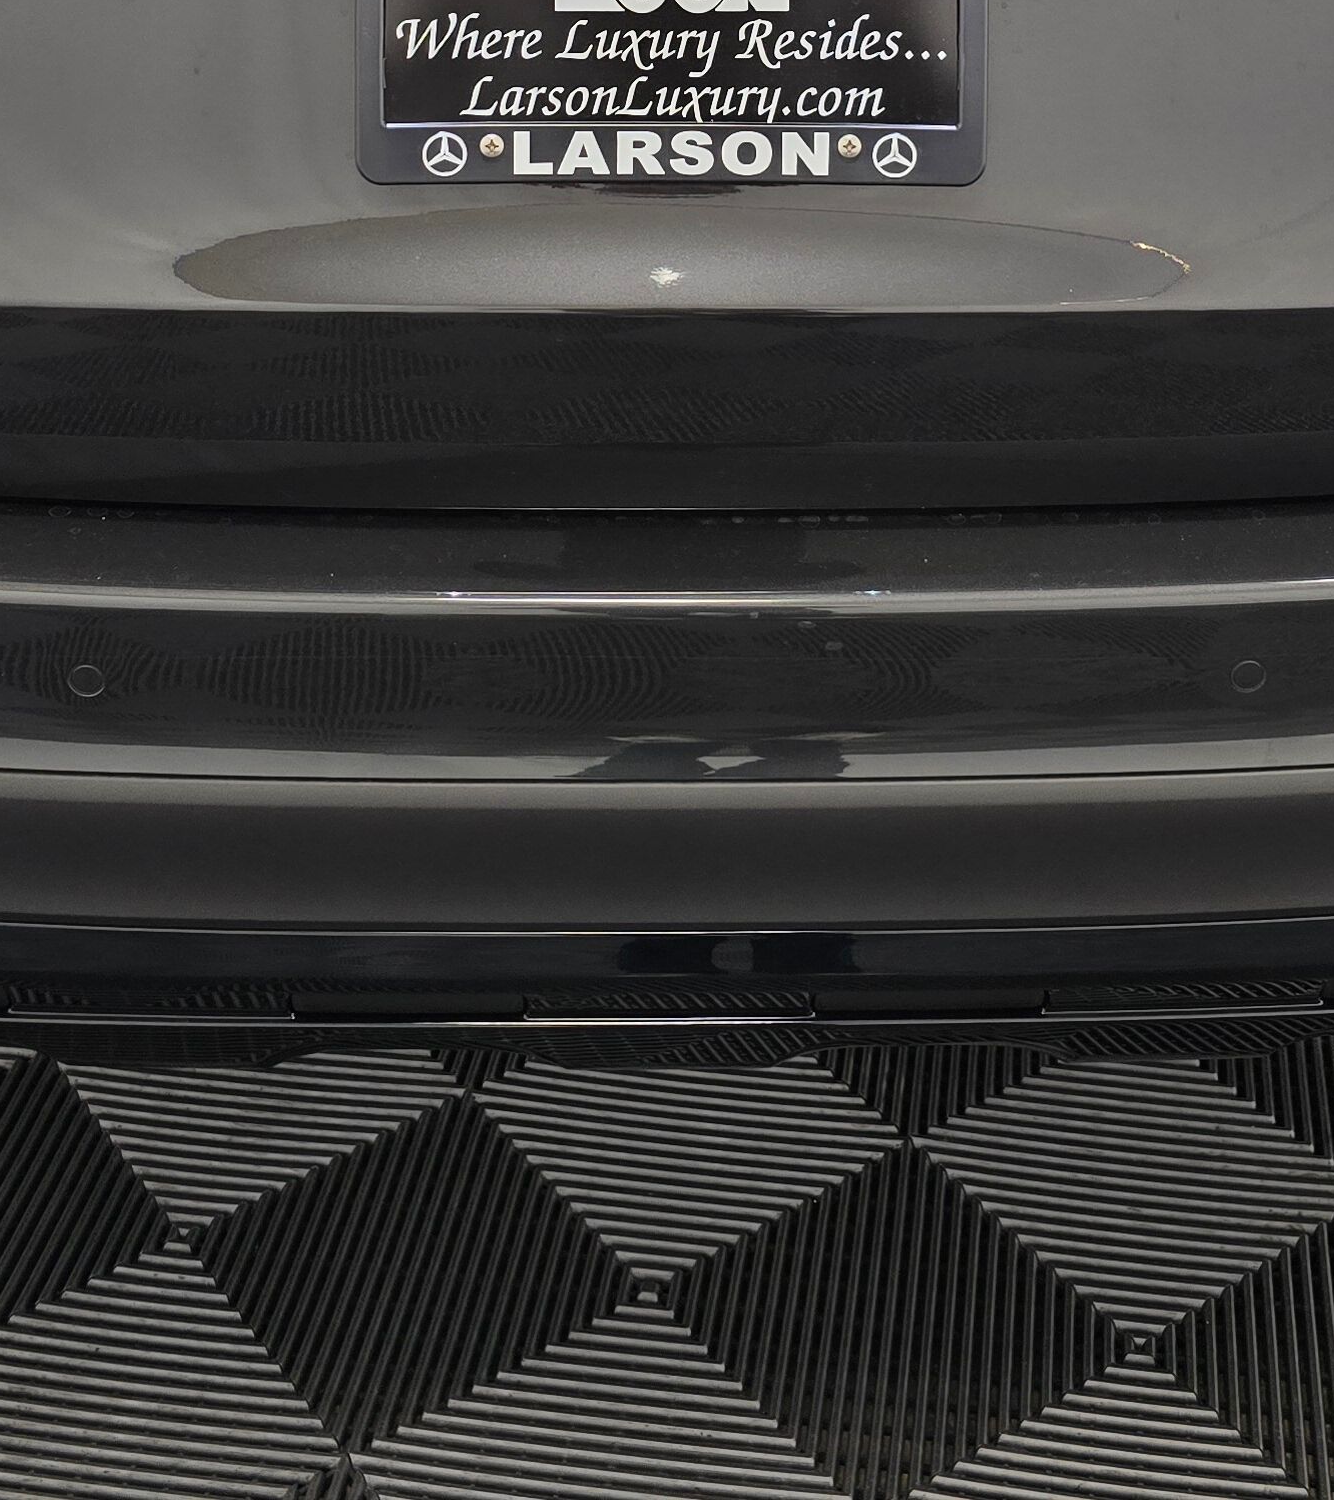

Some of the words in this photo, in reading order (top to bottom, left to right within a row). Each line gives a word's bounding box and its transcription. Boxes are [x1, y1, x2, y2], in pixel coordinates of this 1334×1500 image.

[395, 12, 543, 61] Where
[554, 19, 721, 78] Luxury
[736, 13, 948, 70] Resides...
[460, 76, 886, 123] LarsonLuxury.com
[512, 129, 831, 177] LARSON
